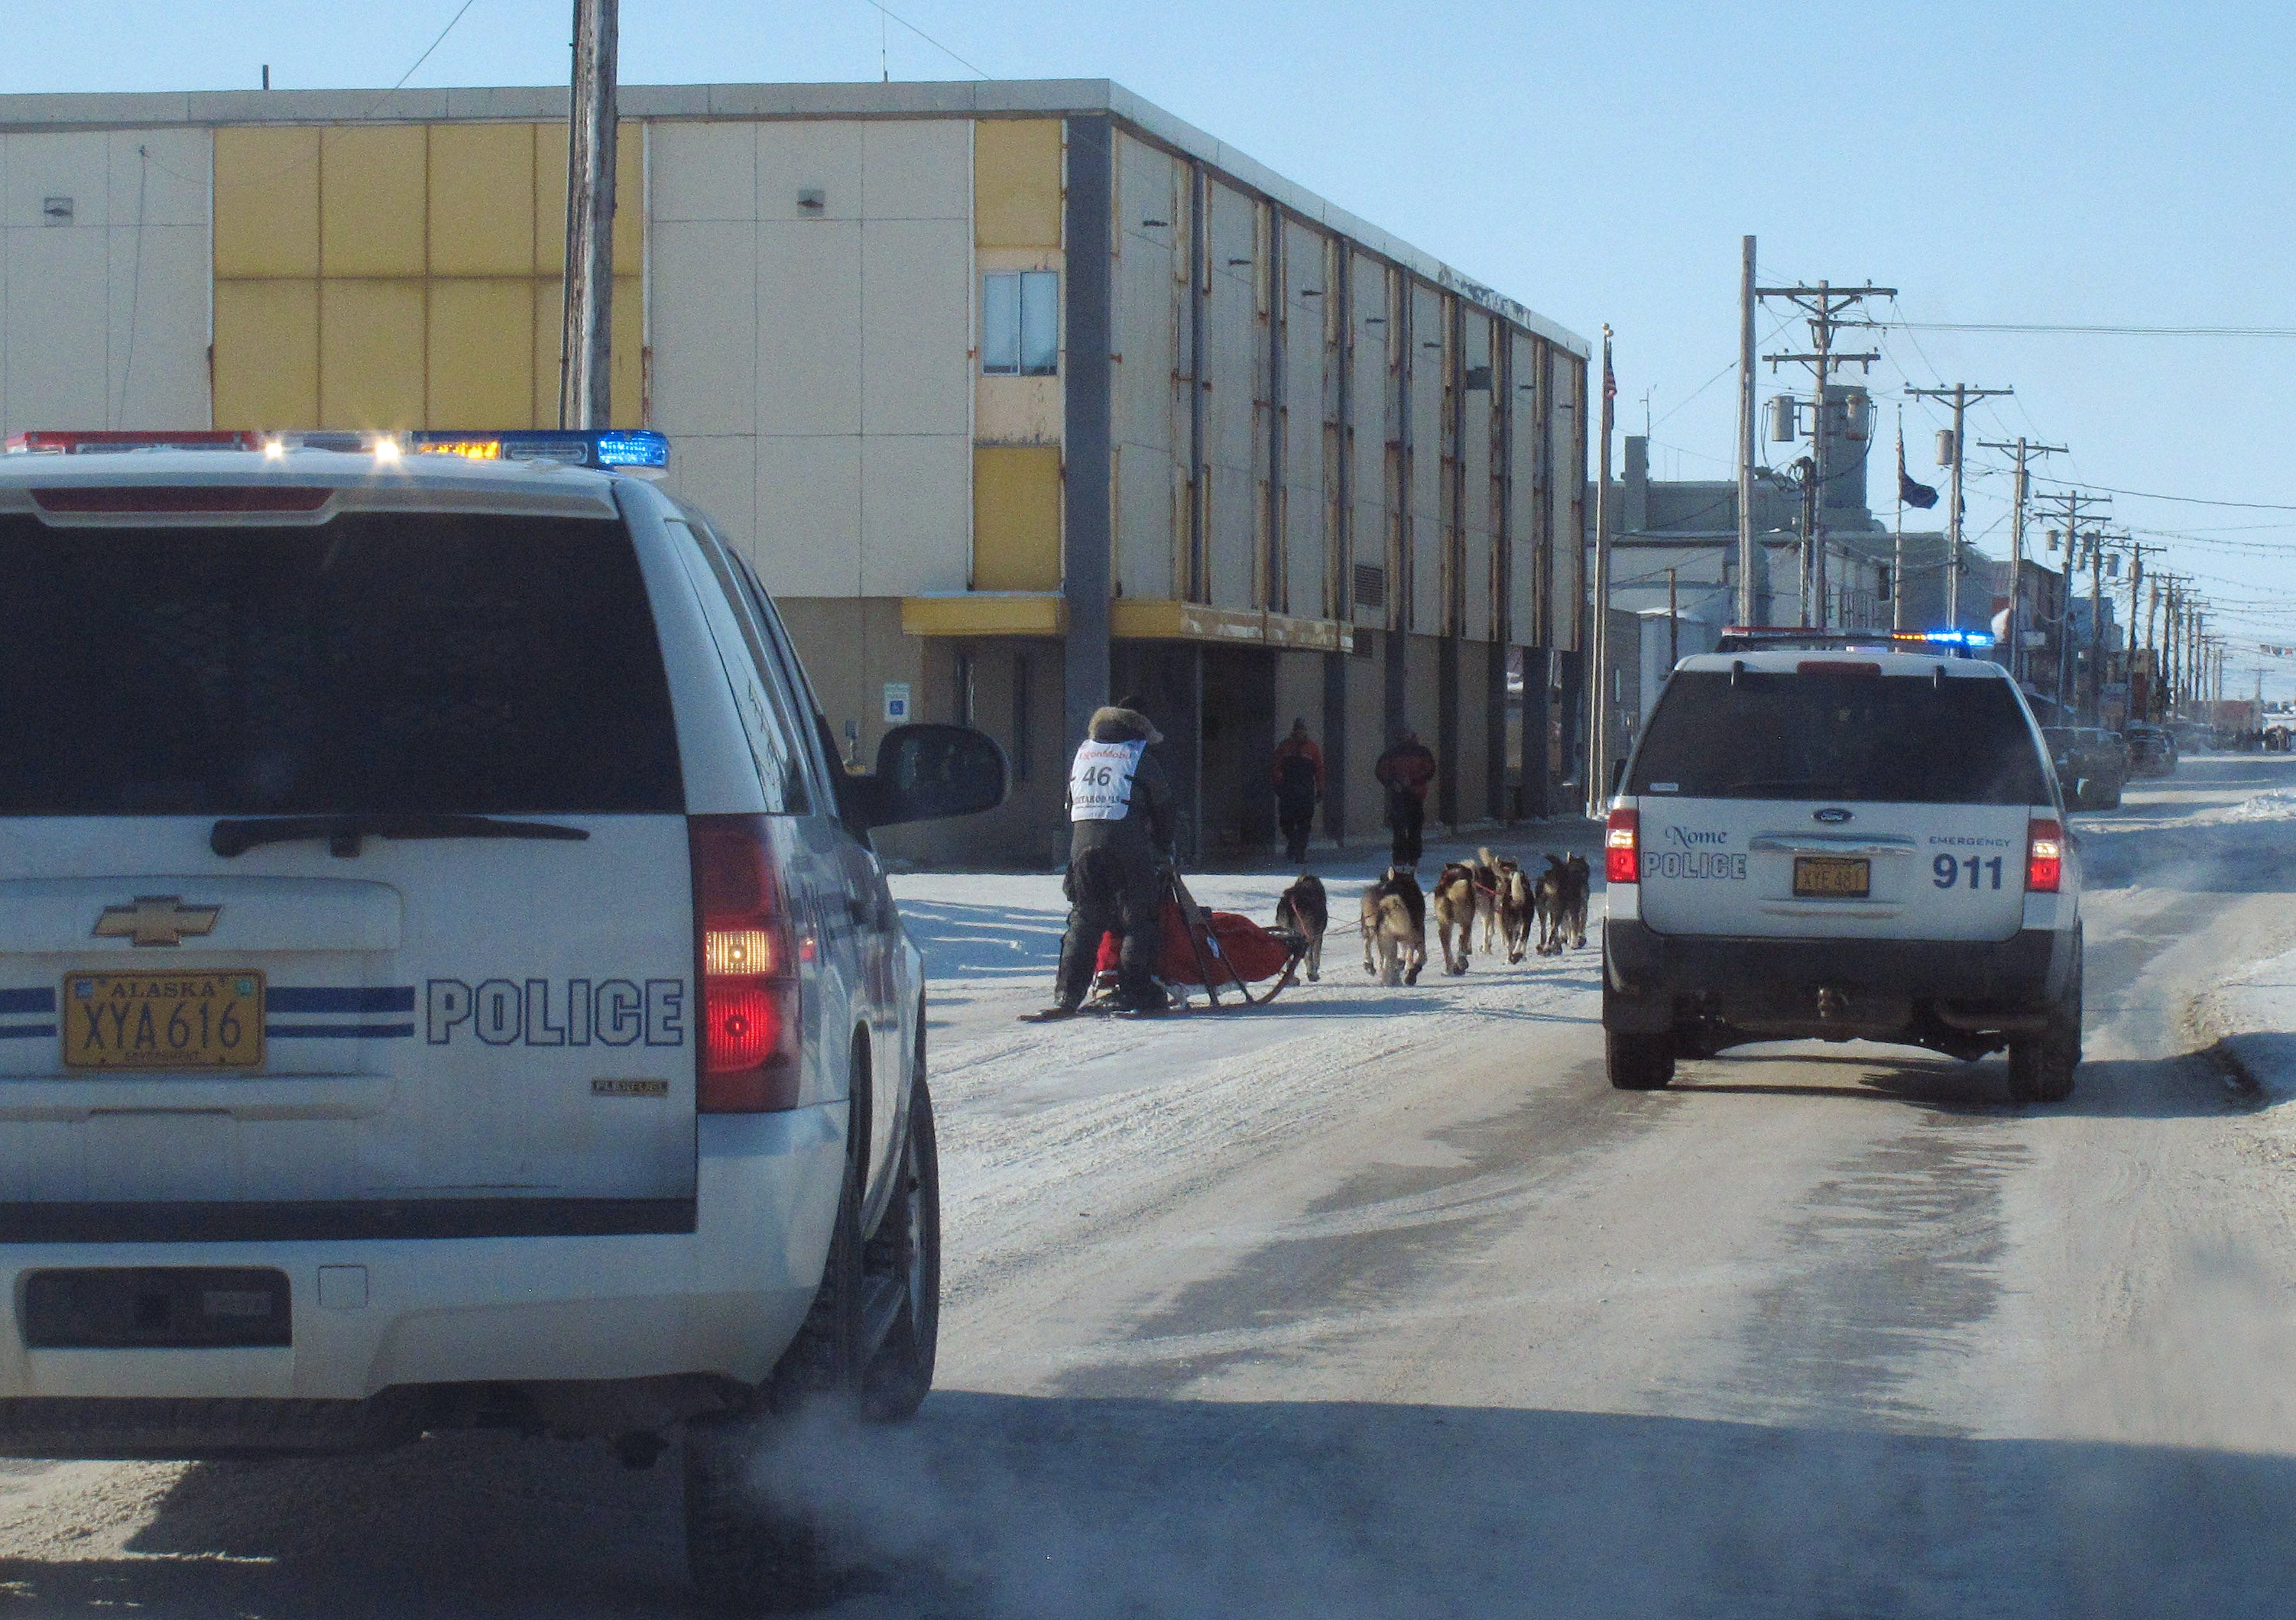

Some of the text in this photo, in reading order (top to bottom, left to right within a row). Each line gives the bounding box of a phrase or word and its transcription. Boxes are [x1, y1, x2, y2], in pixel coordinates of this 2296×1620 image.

[1082, 766, 1113, 786] 46
[1665, 825, 1727, 849] Nome
[1929, 836, 2011, 847] EMERGENCY
[1643, 851, 1747, 880] POLICE
[1932, 853, 2003, 890] 911
[112, 981, 215, 998] ALASKA
[426, 978, 684, 1046] POLICE
